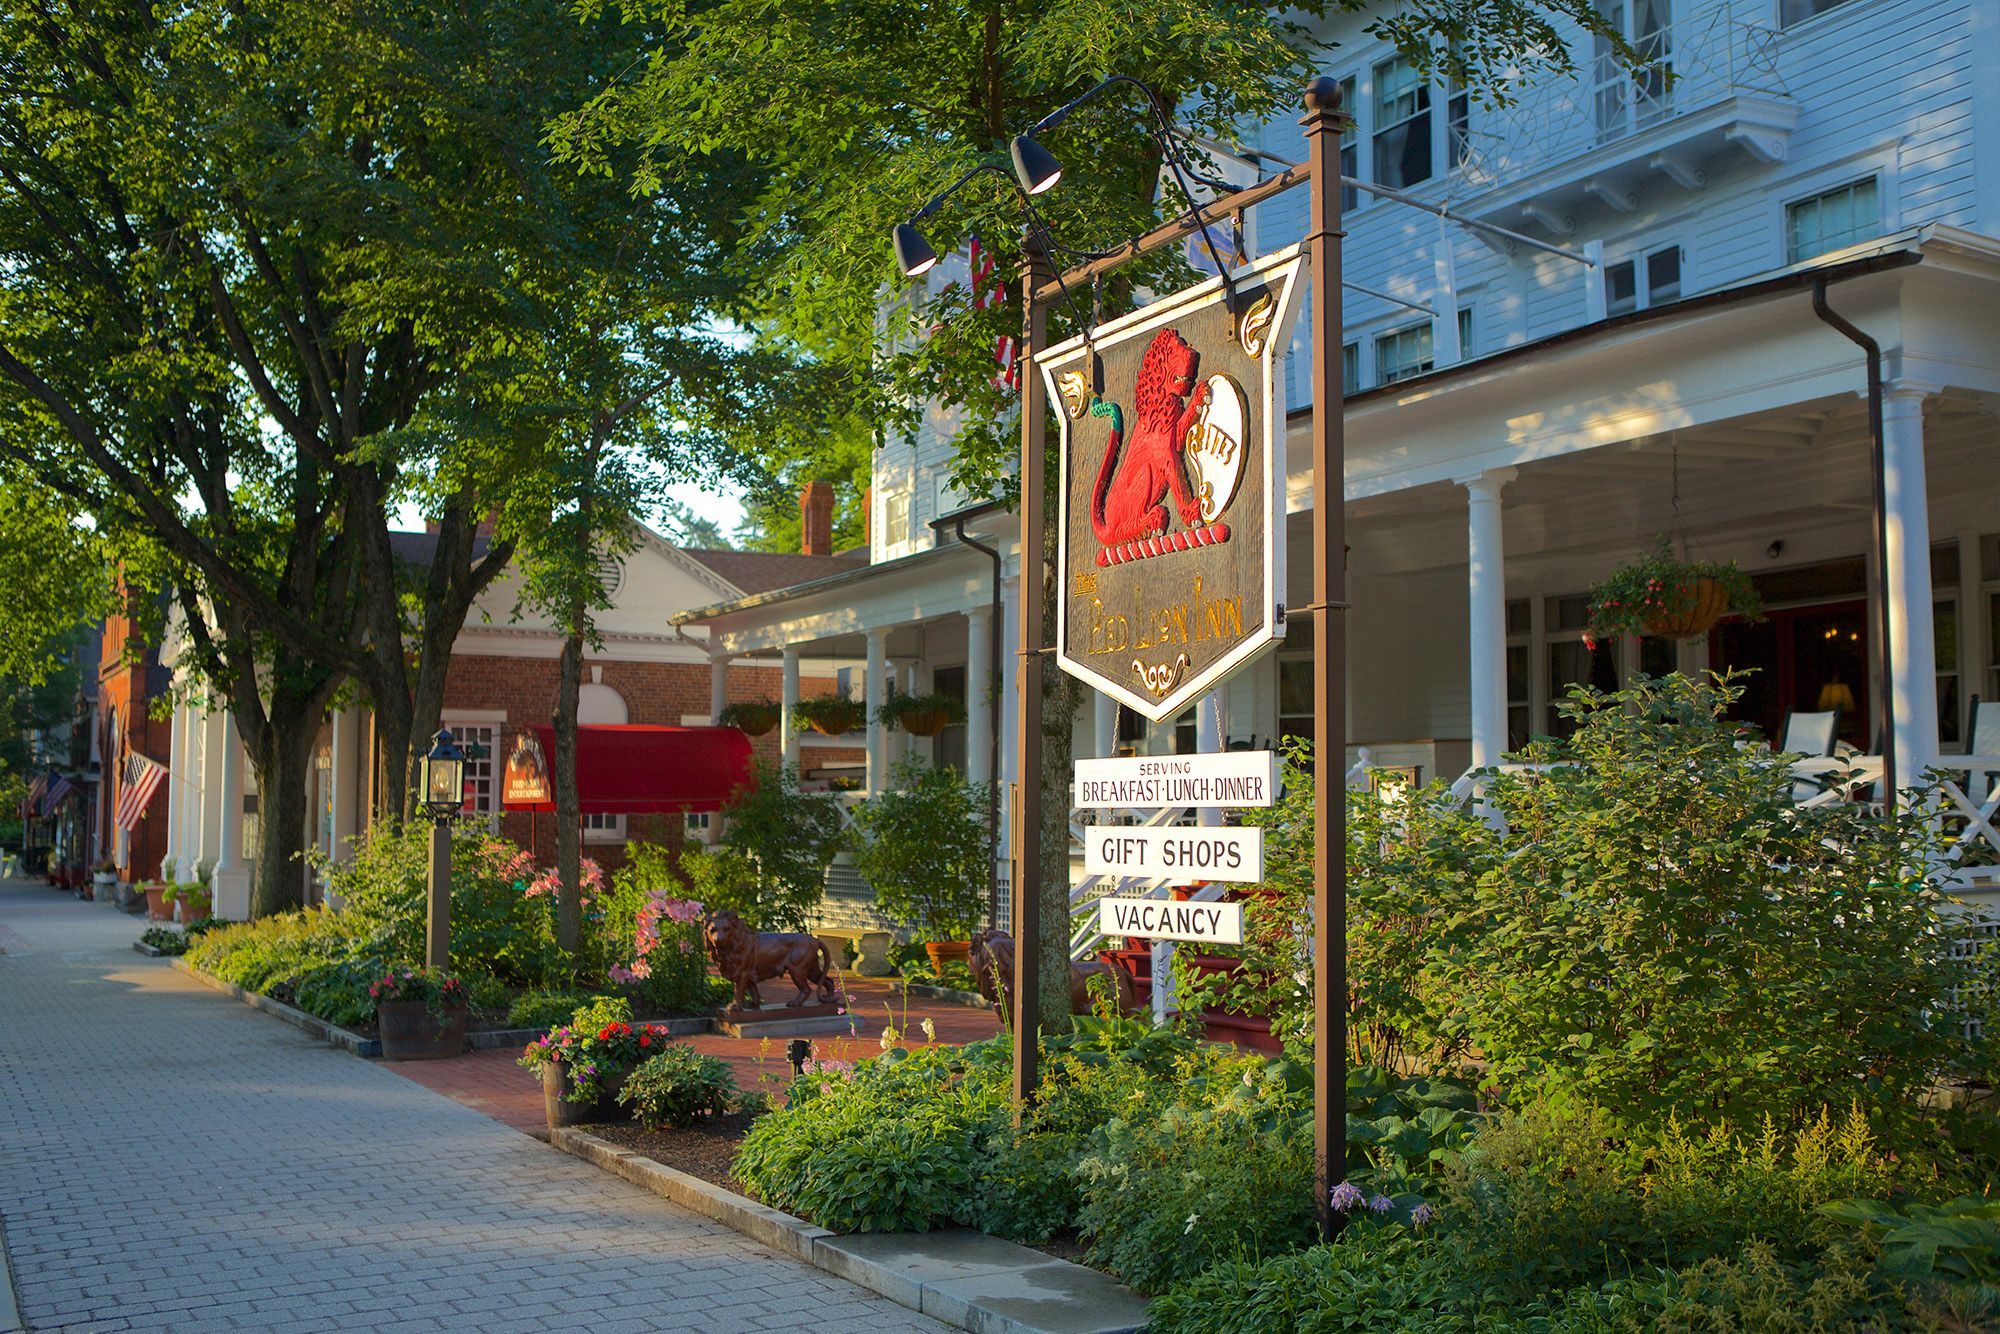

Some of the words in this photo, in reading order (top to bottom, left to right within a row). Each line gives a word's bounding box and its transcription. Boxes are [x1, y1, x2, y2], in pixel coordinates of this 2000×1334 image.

[1075, 572, 1097, 594] THE
[1089, 596, 1129, 655] RED
[1134, 584, 1188, 649] LION
[1194, 575, 1242, 641] INN
[1139, 762, 1191, 776] SERVING
[1102, 838, 1148, 865] GIFT
[1162, 839, 1241, 869] SHOPS
[1114, 905, 1222, 935] VACANCY
